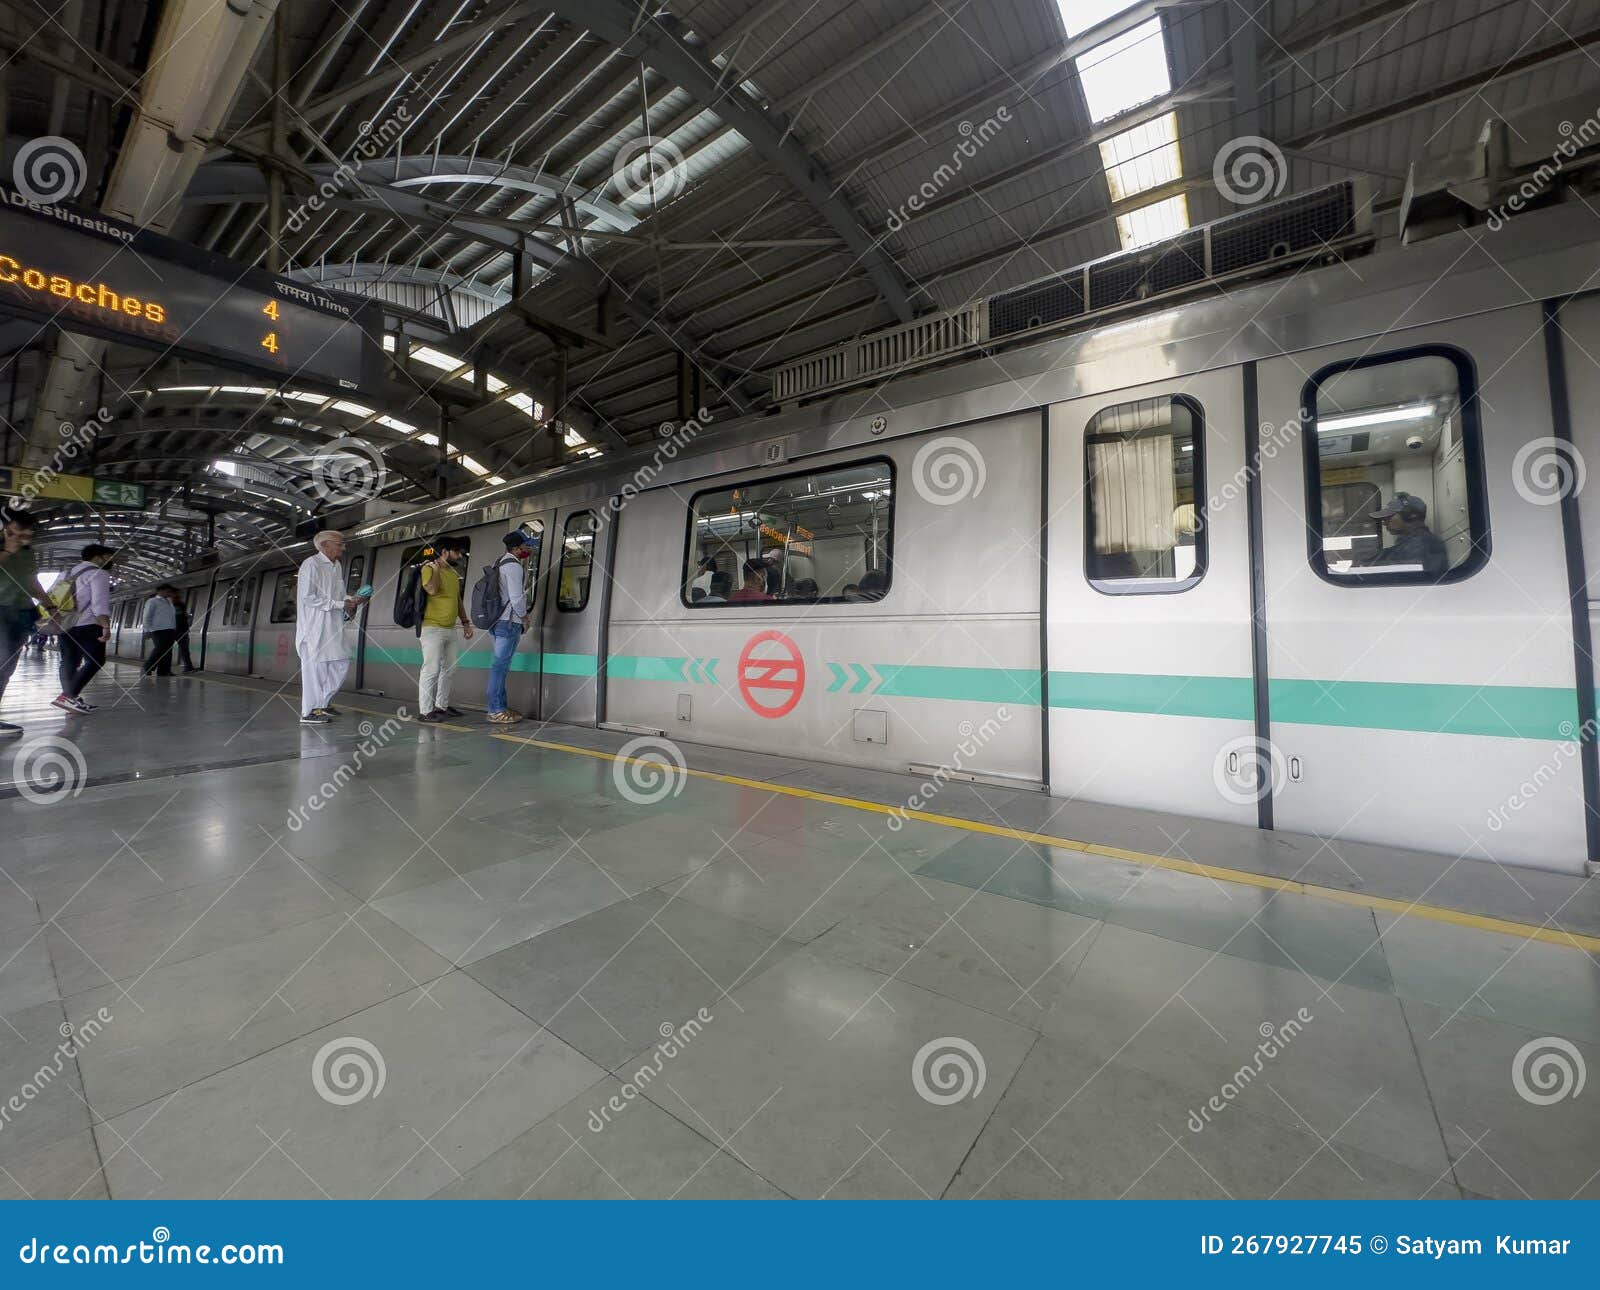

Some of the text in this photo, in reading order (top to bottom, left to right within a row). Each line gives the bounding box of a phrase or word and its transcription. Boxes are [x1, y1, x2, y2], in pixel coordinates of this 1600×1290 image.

[0, 255, 165, 323] Coaches
[263, 300, 280, 320] 4
[262, 333, 279, 353] 4
